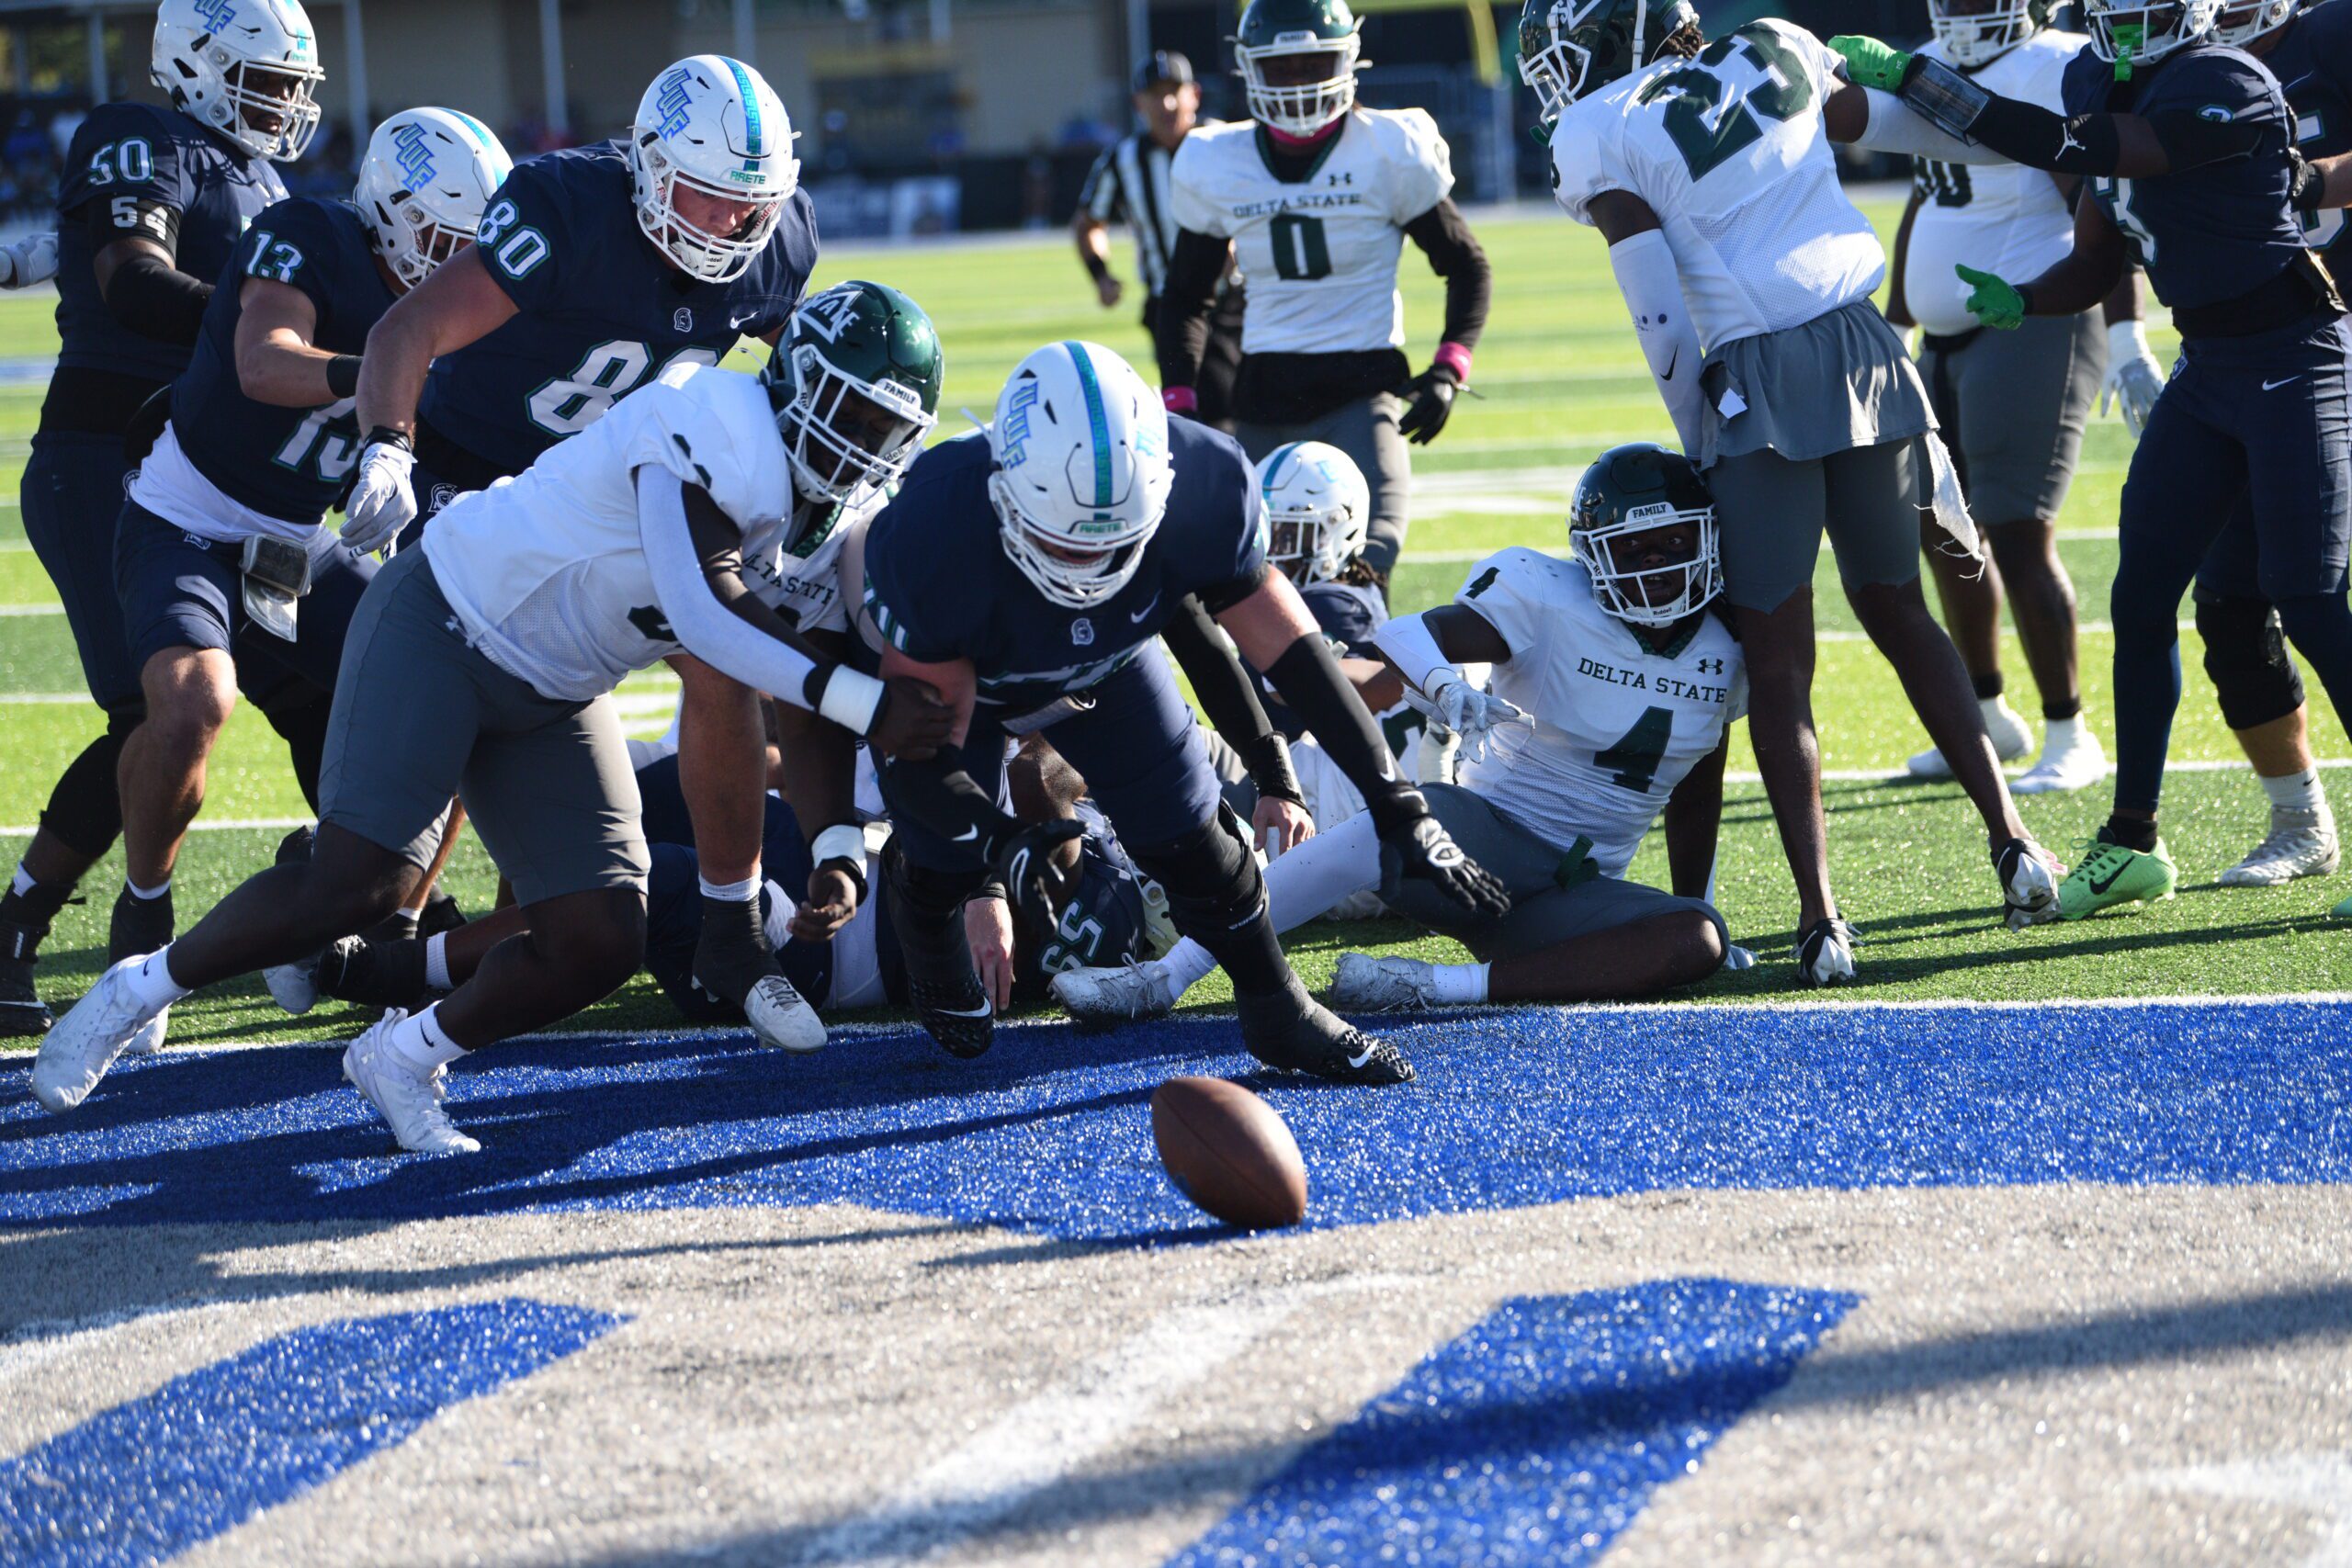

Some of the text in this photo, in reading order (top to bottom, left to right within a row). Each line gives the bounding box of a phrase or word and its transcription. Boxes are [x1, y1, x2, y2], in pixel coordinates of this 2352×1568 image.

[194, 0, 236, 35] WF
[655, 67, 693, 141] UWF
[1637, 21, 1815, 183] 23
[394, 121, 437, 193] UWF
[475, 197, 551, 281] 80
[1232, 193, 1363, 219] DELTA STATE
[244, 230, 305, 285] 13
[1269, 212, 1332, 281] 0
[883, 383, 917, 405] FAMILY
[1001, 380, 1038, 471] UWF
[1633, 503, 1668, 520] FAMILY
[1577, 657, 1727, 704] DELTA STATE
[1593, 705, 1674, 794] 4
